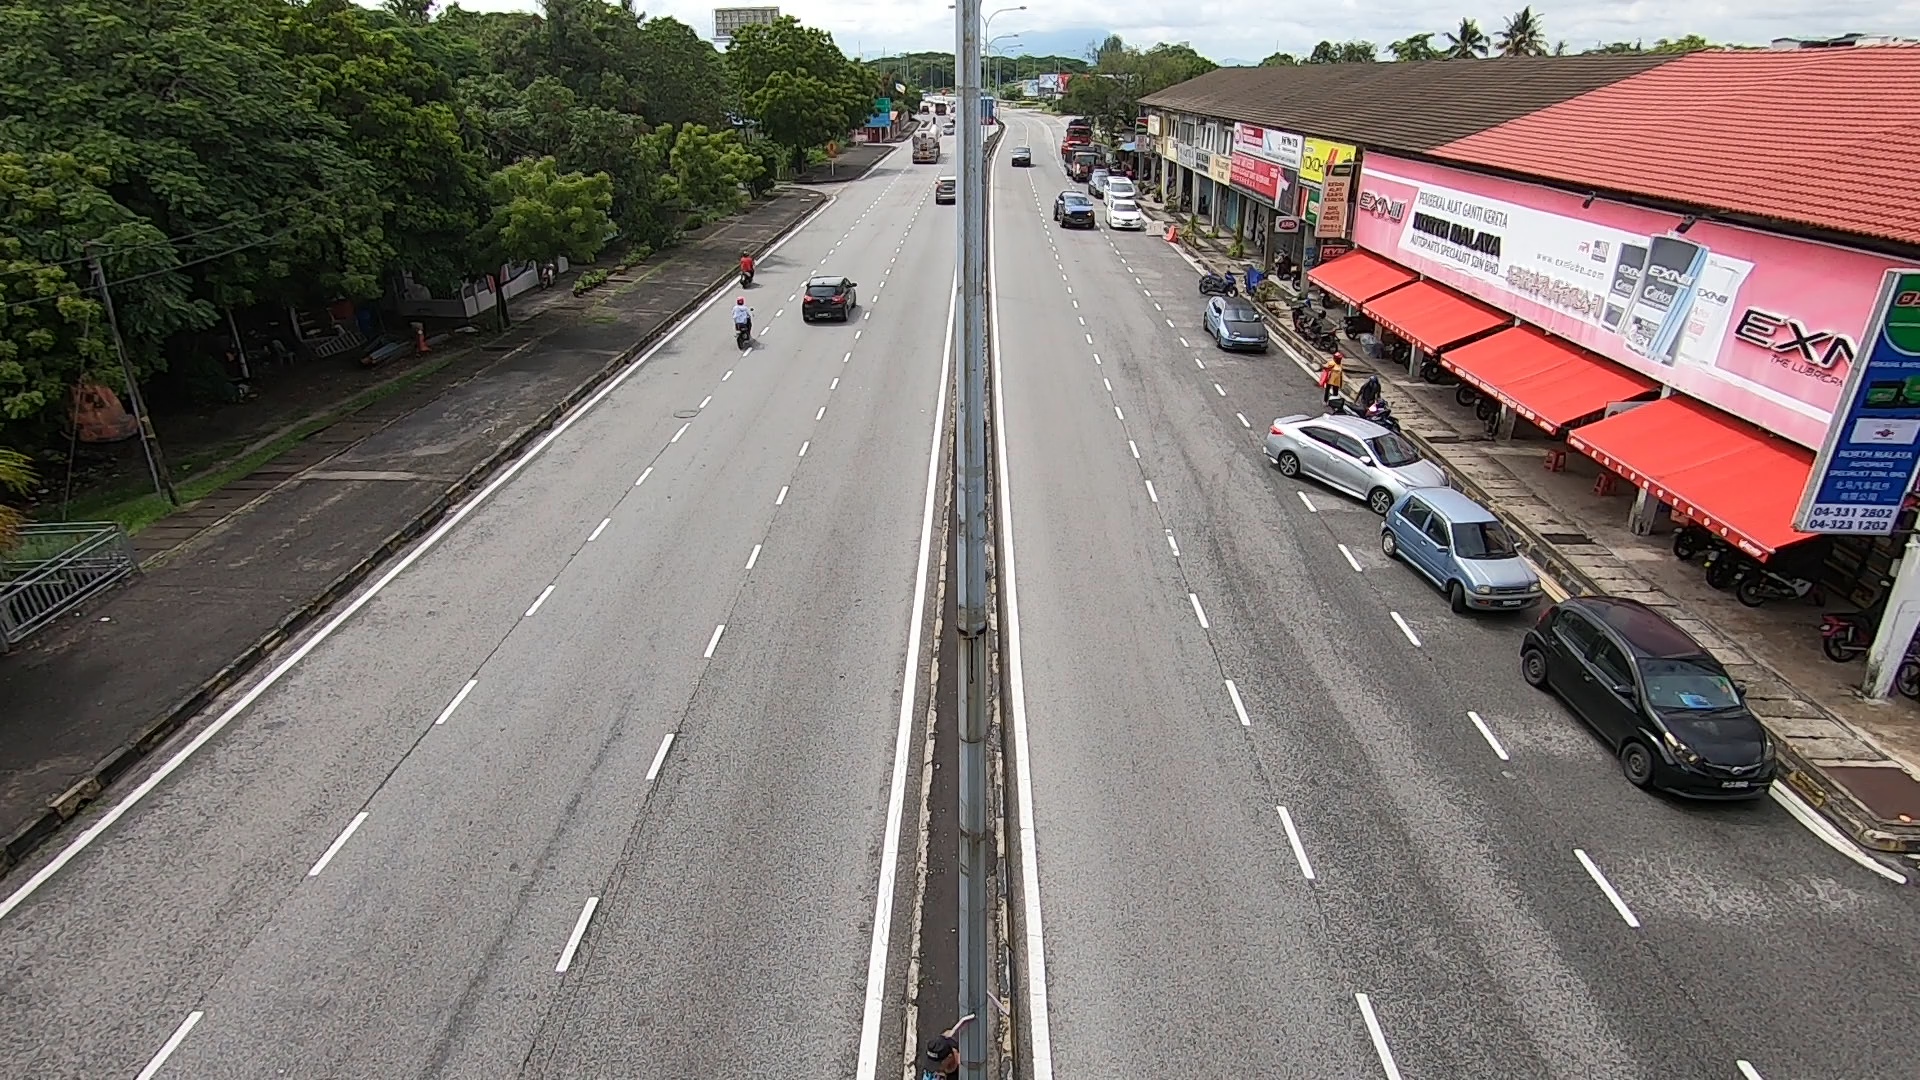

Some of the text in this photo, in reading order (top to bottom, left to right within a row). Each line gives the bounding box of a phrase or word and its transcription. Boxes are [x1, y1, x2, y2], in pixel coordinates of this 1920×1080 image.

[1484, 207, 1508, 229] KERETA
[1412, 211, 1502, 258] NORTH MALAYA
[1440, 244, 1471, 265] SPECIALIST
[1770, 353, 1792, 368] THE
[1838, 450, 1873, 458] NORTH
[1814, 507, 1857, 517] 04-331
[1809, 519, 1853, 529] 04-323
